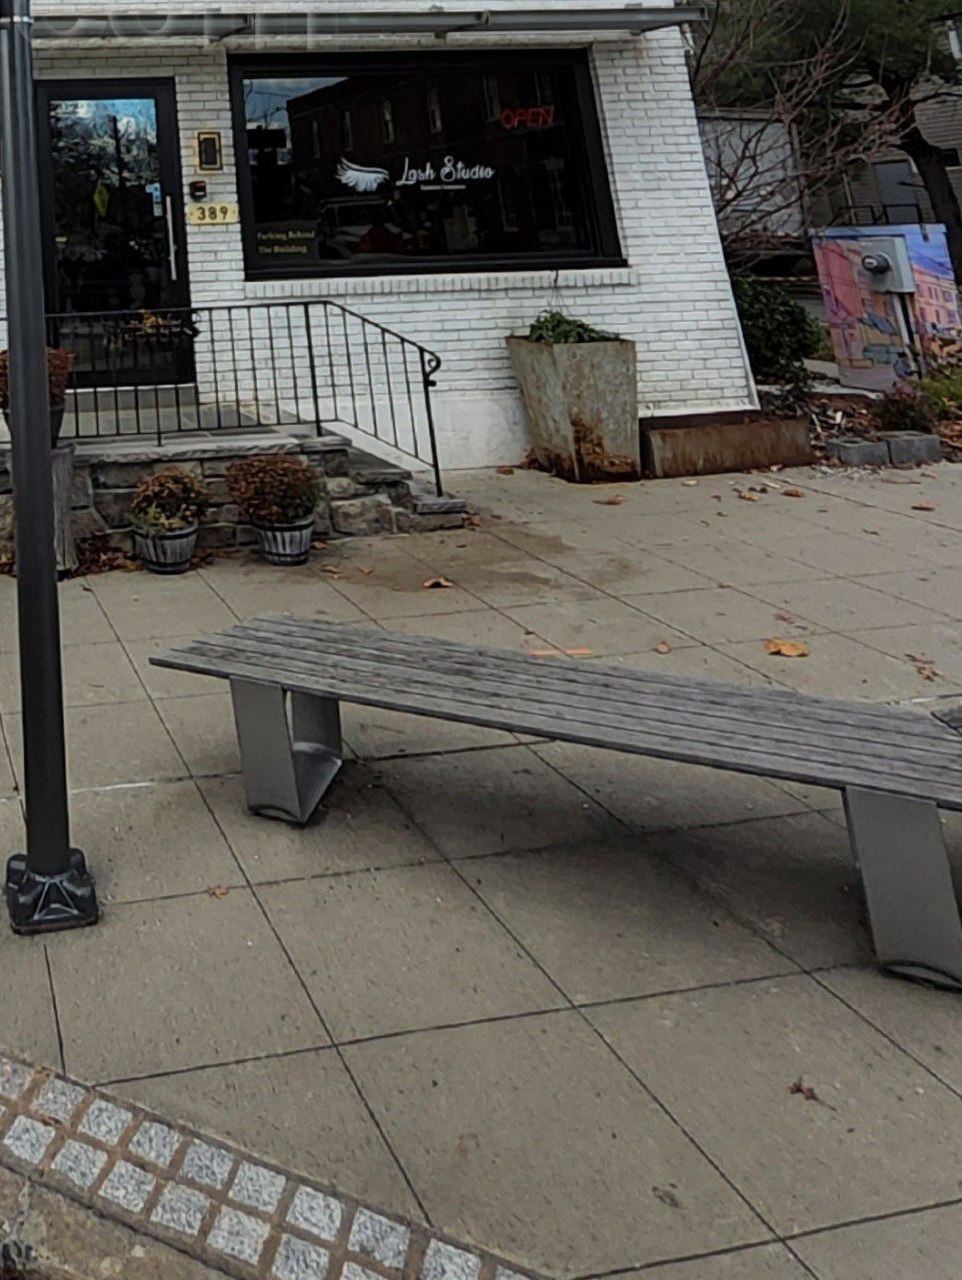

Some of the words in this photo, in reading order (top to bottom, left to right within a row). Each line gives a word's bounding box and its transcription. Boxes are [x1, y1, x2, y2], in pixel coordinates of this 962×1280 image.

[500, 105, 555, 129] OPEN
[395, 156, 436, 186] Lash
[440, 155, 496, 182] Studio
[196, 205, 229, 221] 389
